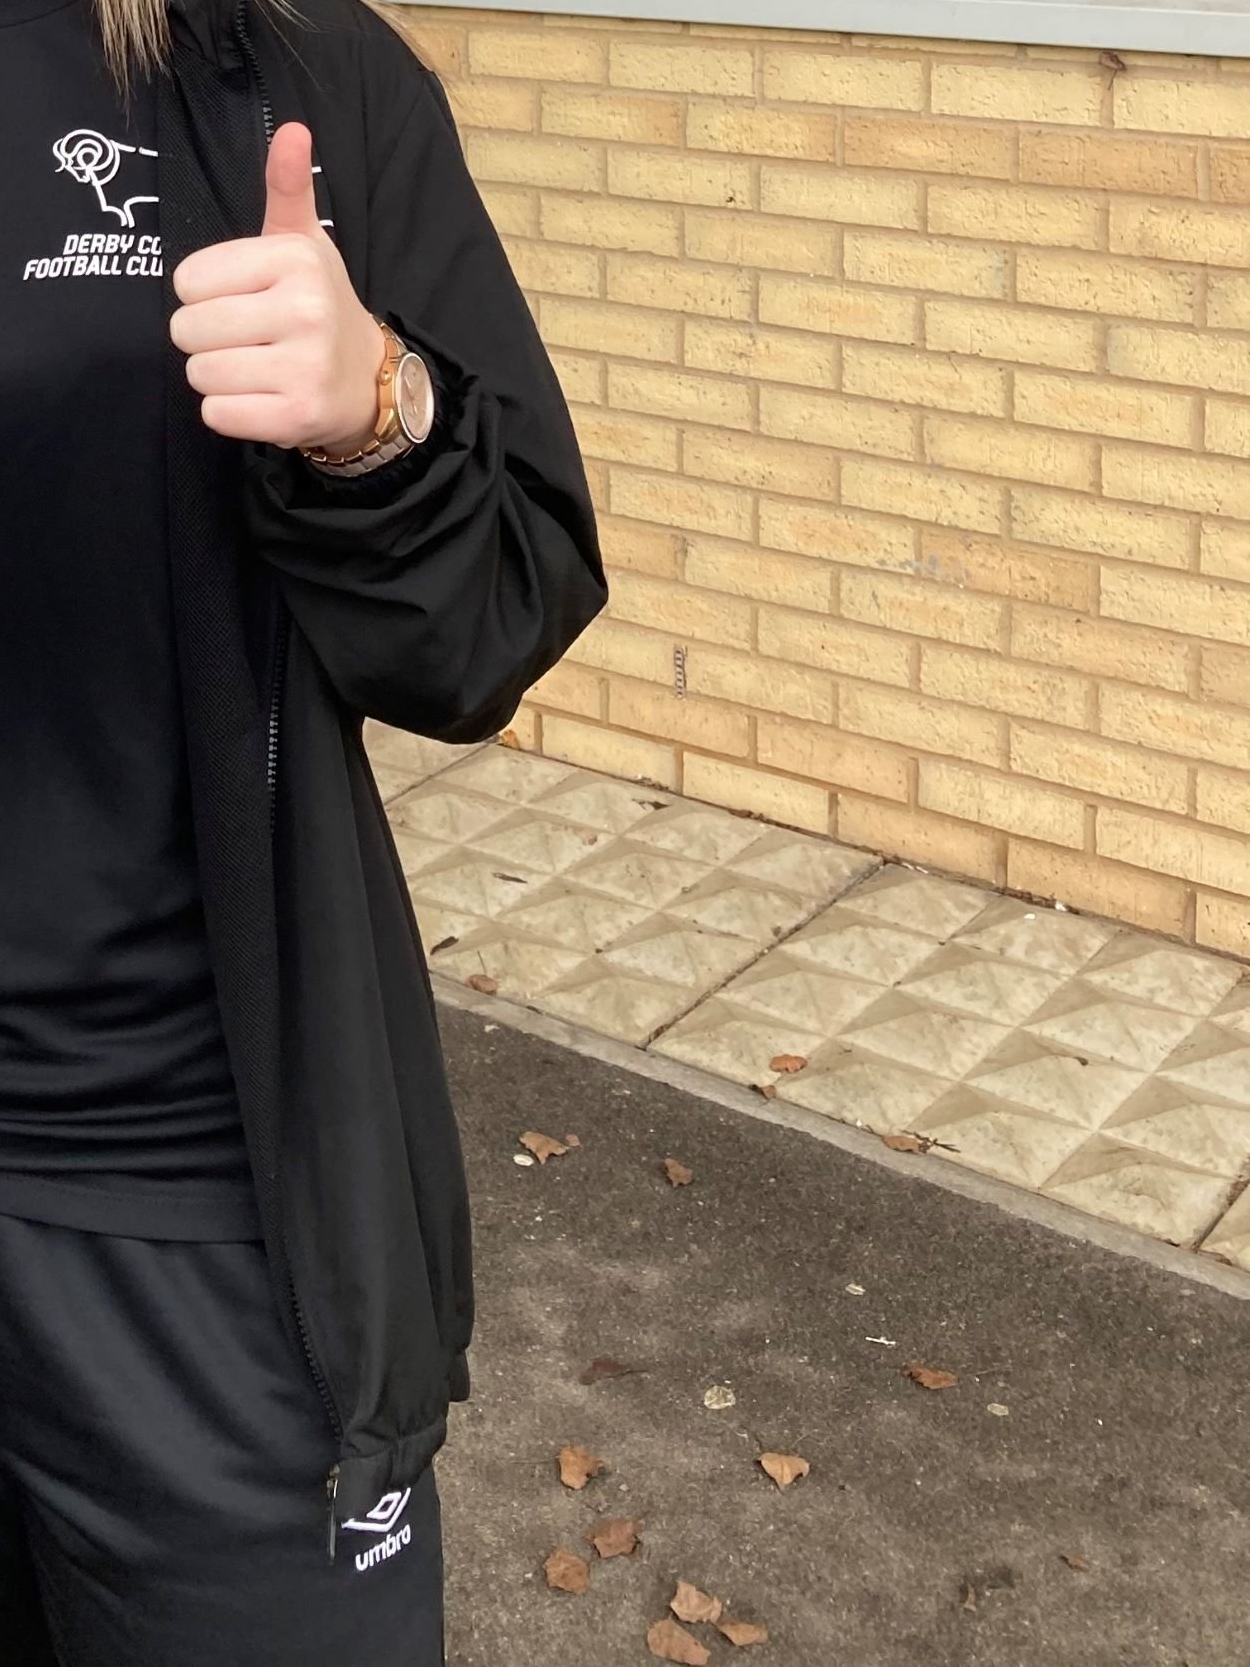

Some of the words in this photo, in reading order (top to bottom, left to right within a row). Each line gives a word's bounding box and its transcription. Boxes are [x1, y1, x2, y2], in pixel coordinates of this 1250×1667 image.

[62, 233, 135, 256] DERBY
[22, 255, 122, 281] FOOTBALL
[125, 255, 164, 277] CLU
[355, 1524, 412, 1571] umbro
